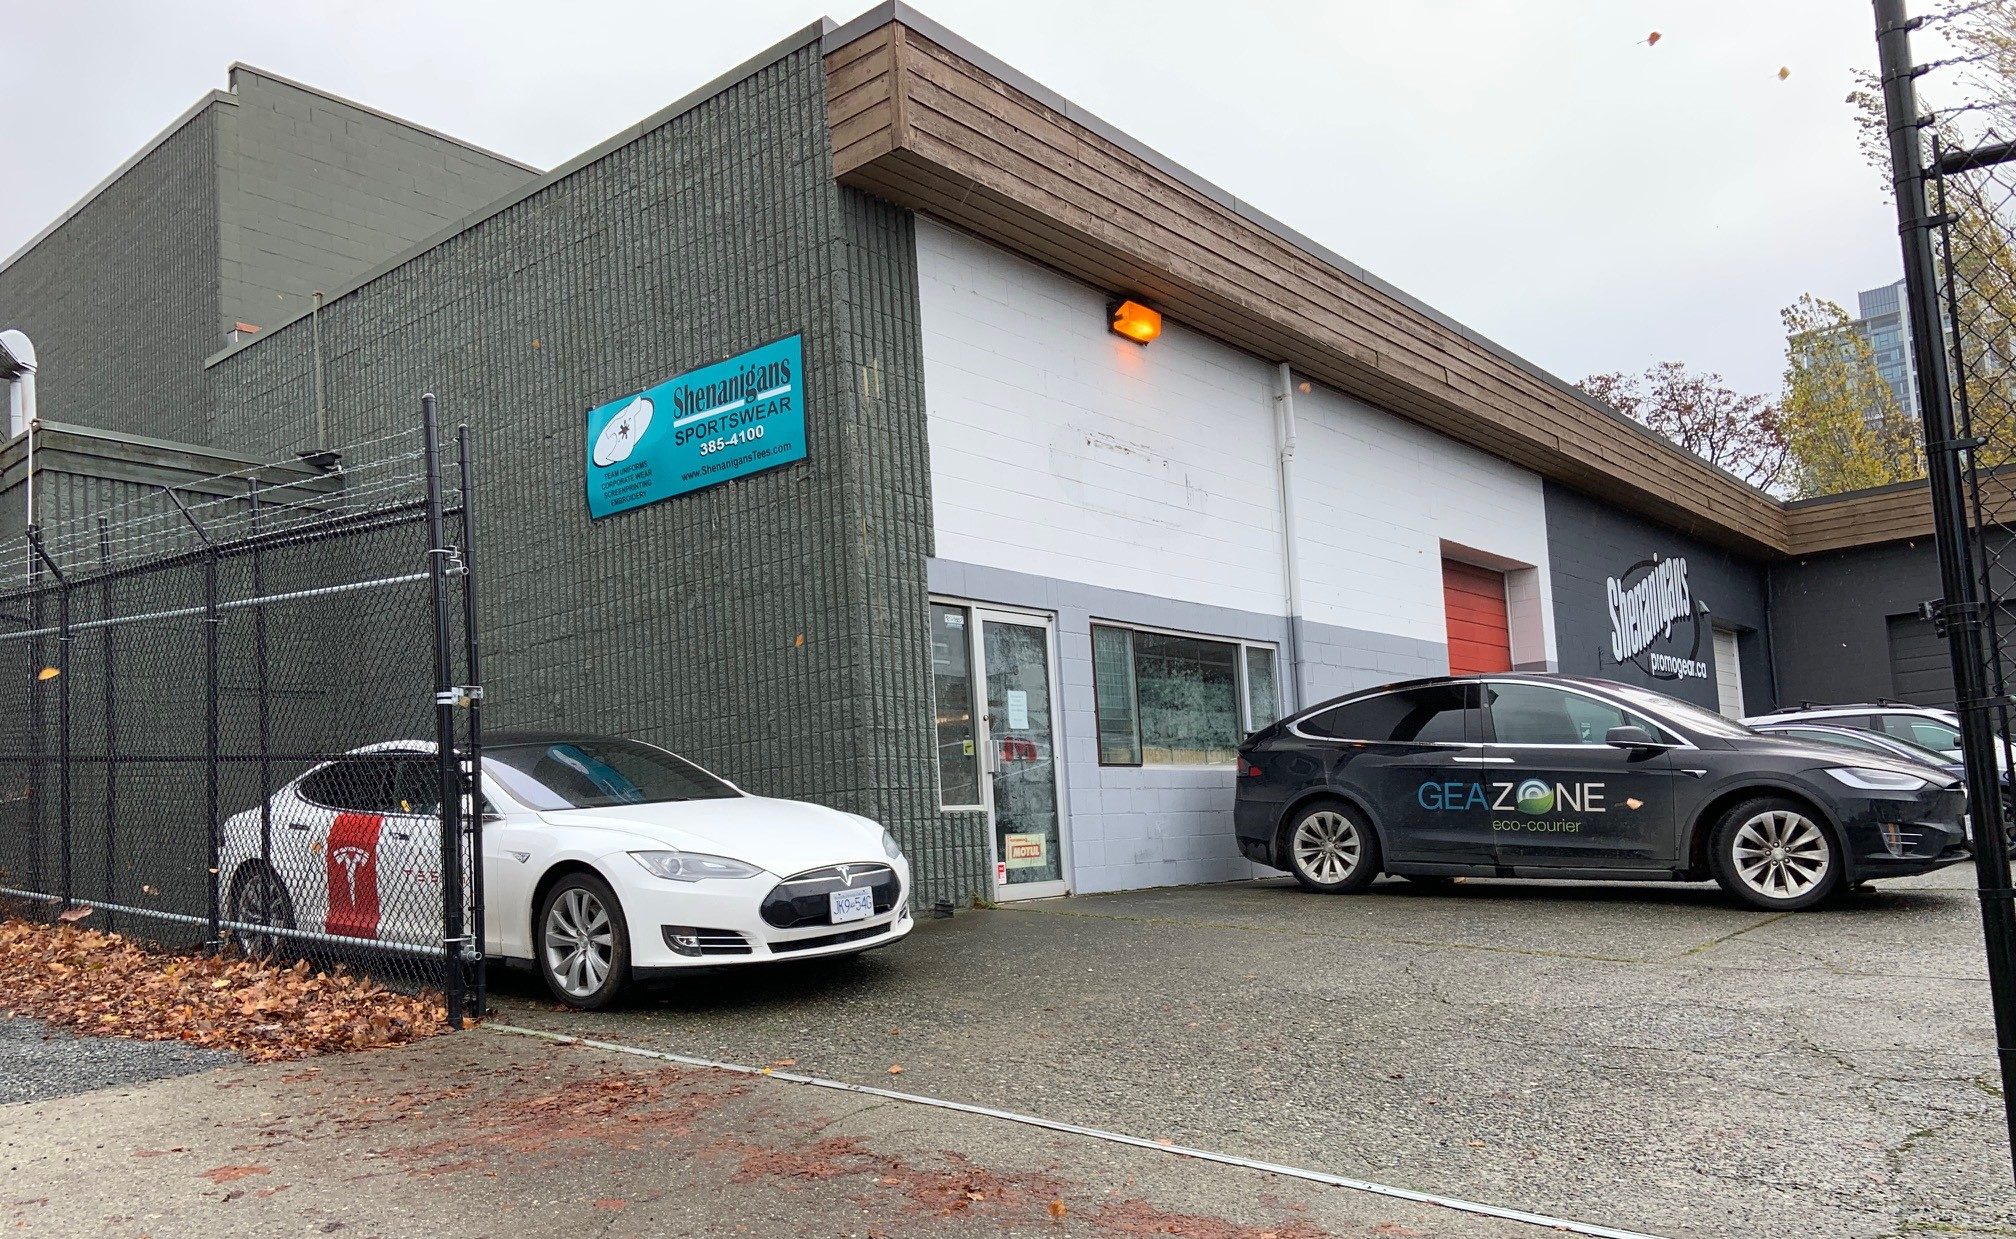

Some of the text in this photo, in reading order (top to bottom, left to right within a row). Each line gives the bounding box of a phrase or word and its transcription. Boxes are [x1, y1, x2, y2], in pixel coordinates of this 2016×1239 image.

[673, 358, 791, 420] Shenanigans
[674, 396, 792, 446] SPORTSWEAR
[699, 425, 765, 456] 385-4100
[681, 442, 792, 482] www.ShenanigansTees.com
[1606, 552, 1691, 662] Shenanigans
[1650, 652, 1707, 680] promogear.ca
[1492, 818, 1581, 833] eco-courier
[1012, 845, 1040, 858] MOTUL
